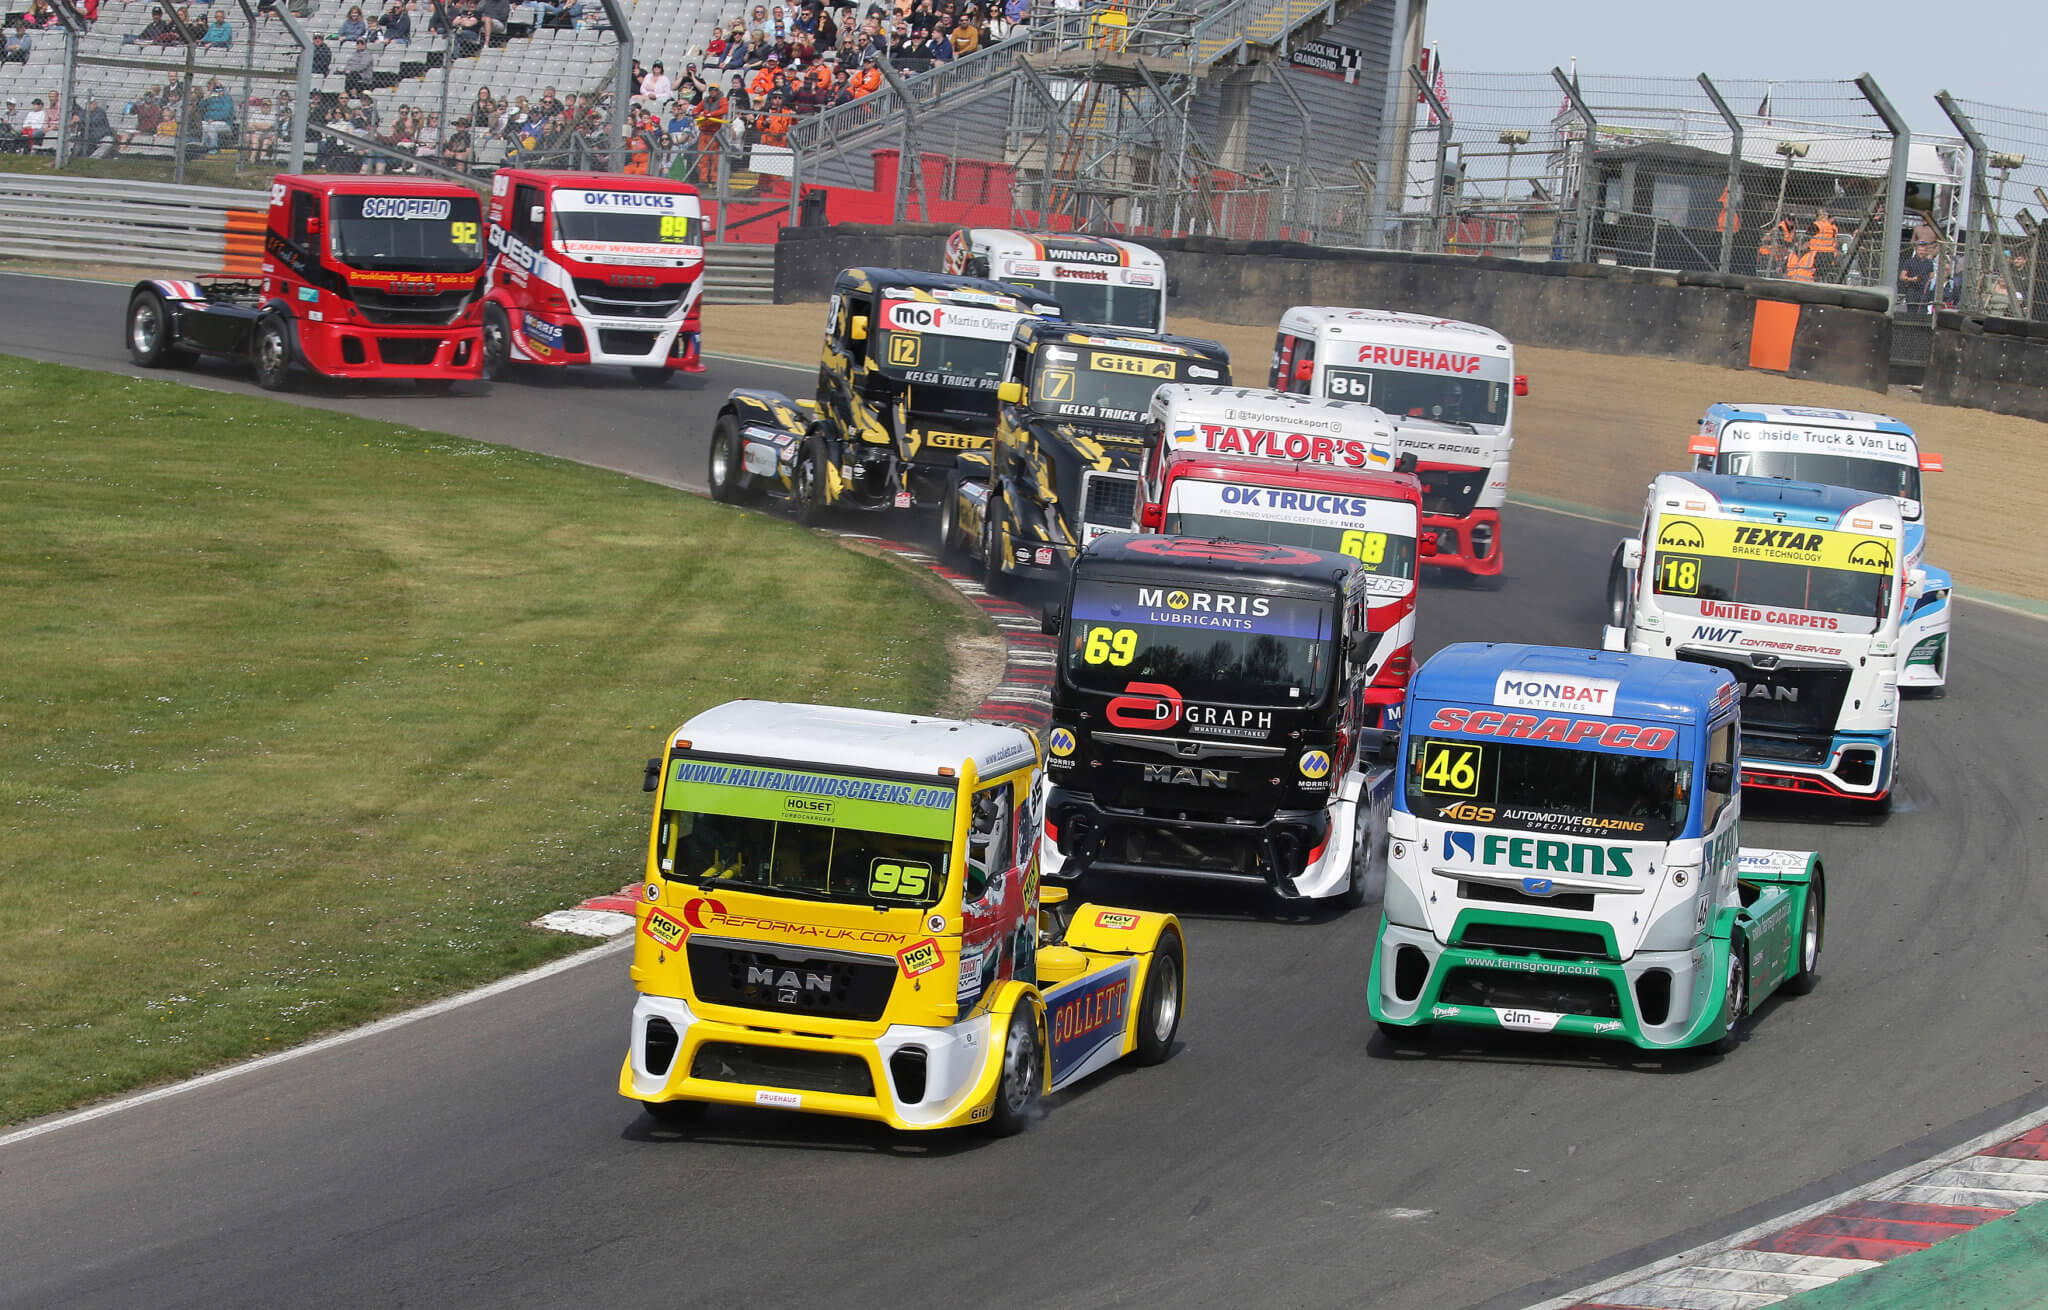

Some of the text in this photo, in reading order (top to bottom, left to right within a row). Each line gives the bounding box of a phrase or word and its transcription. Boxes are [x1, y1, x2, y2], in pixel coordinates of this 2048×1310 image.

[1293, 52, 1337, 71] GRANDSTAND
[1325, 45, 1340, 59] HILL
[271, 184, 286, 207] 92
[584, 193, 674, 208] OK TRUCKS
[362, 198, 451, 220] SCHOFIELD
[451, 222, 478, 244] 92
[660, 216, 688, 237] 89
[488, 224, 545, 275] GUEST
[609, 245, 699, 257] WINDSCREENS
[1048, 249, 1118, 263] WINNARD
[610, 274, 656, 286] IVECO
[1054, 266, 1109, 281] Screentek
[390, 282, 435, 293] IVECO
[524, 313, 563, 337] MORRIS
[948, 313, 979, 328] Martin
[981, 317, 1009, 332] Oliver
[894, 339, 915, 362] 12
[1358, 345, 1481, 374] FRUEHAUF
[1097, 357, 1143, 373] Giti
[905, 371, 939, 385] KELSA
[942, 374, 977, 388] TRUCK
[1049, 374, 1069, 397] 7
[1059, 404, 1095, 417] KELSA
[1100, 407, 1138, 421] TRUCK
[1238, 411, 1329, 429] @taylorstrucksport
[932, 434, 973, 449] Giti
[1200, 424, 1367, 468] TAYLOR'S
[1398, 439, 1480, 455] TRUCK RACING
[1733, 429, 1907, 452] Nothside Truck & Van Ltd
[1221, 487, 1367, 517] OK TRUCKS
[1261, 512, 1292, 522] VEHICLES
[1340, 520, 1365, 529] IVECO
[1340, 529, 1388, 564] 68
[1662, 537, 1700, 548] MAN
[1733, 526, 1824, 552] TEXTAR
[1732, 546, 1822, 562] BRAKE TECHNOLOGY
[1851, 556, 1889, 568] MAN
[1665, 560, 1697, 590] 18
[1138, 588, 1270, 617] MORRIS
[1150, 612, 1252, 630] LUBRICANTS
[1766, 611, 1838, 630] CARPETS
[1084, 627, 1138, 667] 69
[1692, 625, 1842, 656] NWT CONTAINER SERVICES
[1503, 680, 1608, 704] MONBAT
[1518, 698, 1585, 711] BATTERIES
[1155, 703, 1272, 729] DIGRAPH
[1194, 725, 1231, 735] WHATEVER
[1243, 730, 1266, 738] TAKES
[1429, 708, 1677, 751] SCRAPCO
[1144, 764, 1229, 789] MAN
[1425, 750, 1475, 790] 46
[675, 761, 957, 810] WWW.HALIFAXWINDSCREENS.COM
[1298, 780, 1329, 788] MORRIS
[787, 798, 832, 812] HOLSET
[781, 812, 836, 823] TURBOCHARGERS
[1526, 821, 1608, 836] SPECIALISTS
[1483, 834, 1633, 877] FERNS
[870, 864, 929, 896] 95
[652, 915, 682, 937] HGV
[653, 926, 673, 941] DIRECT
[710, 913, 906, 944] REFORMA-UK.COM
[904, 946, 932, 966] HGV
[913, 958, 933, 970] DIRECT
[1465, 956, 1600, 977] www.fernsgroup.co.uk
[747, 966, 832, 993] MAN
[1054, 978, 1128, 1047] COLLETT
[759, 1092, 798, 1105] FRUEHAUF
[971, 1105, 989, 1120] Giti
